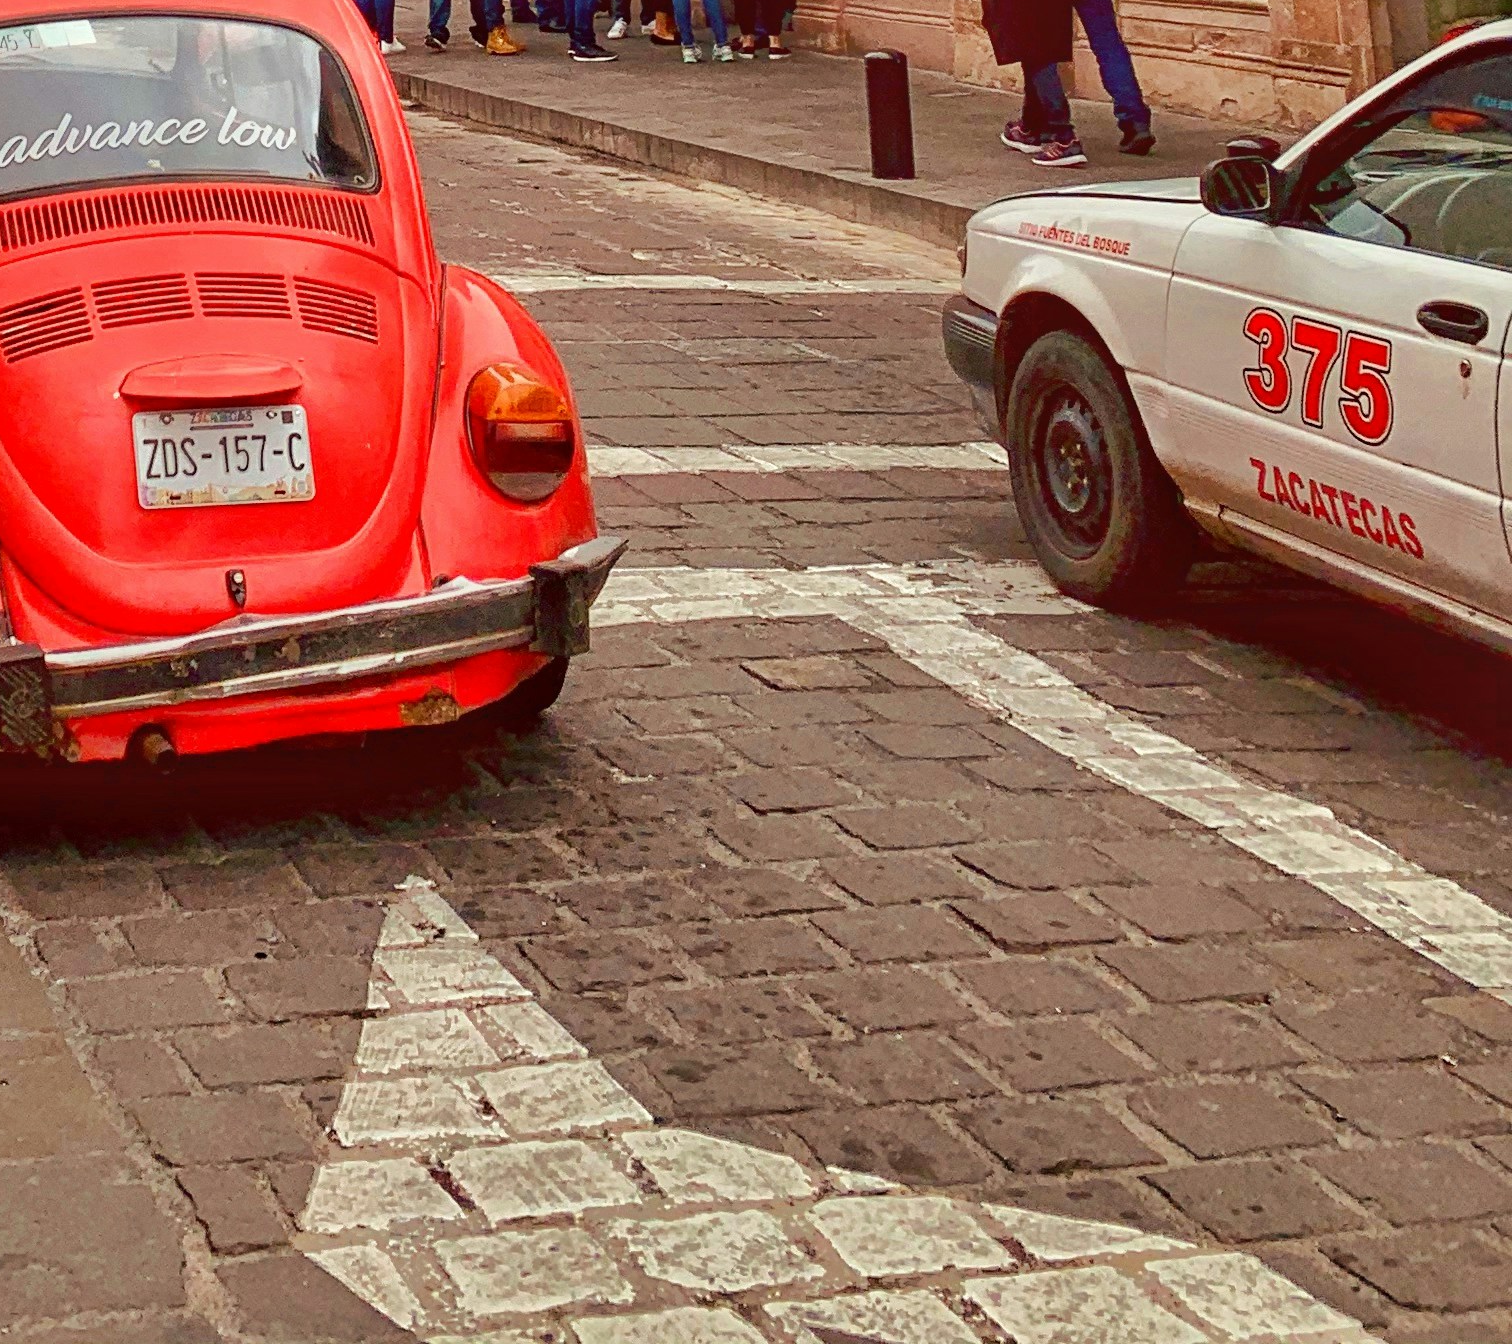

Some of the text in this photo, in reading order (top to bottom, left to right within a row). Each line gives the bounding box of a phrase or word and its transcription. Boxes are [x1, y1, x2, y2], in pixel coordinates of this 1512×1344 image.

[217, 106, 297, 150] low
[1039, 225, 1075, 244] FUENTES
[1076, 232, 1090, 248] DEL
[1093, 236, 1130, 255] BOSQUE
[1243, 306, 1394, 446] 375
[143, 432, 305, 479] ZDS-157-C
[1249, 457, 1424, 560] ZACATECAS
